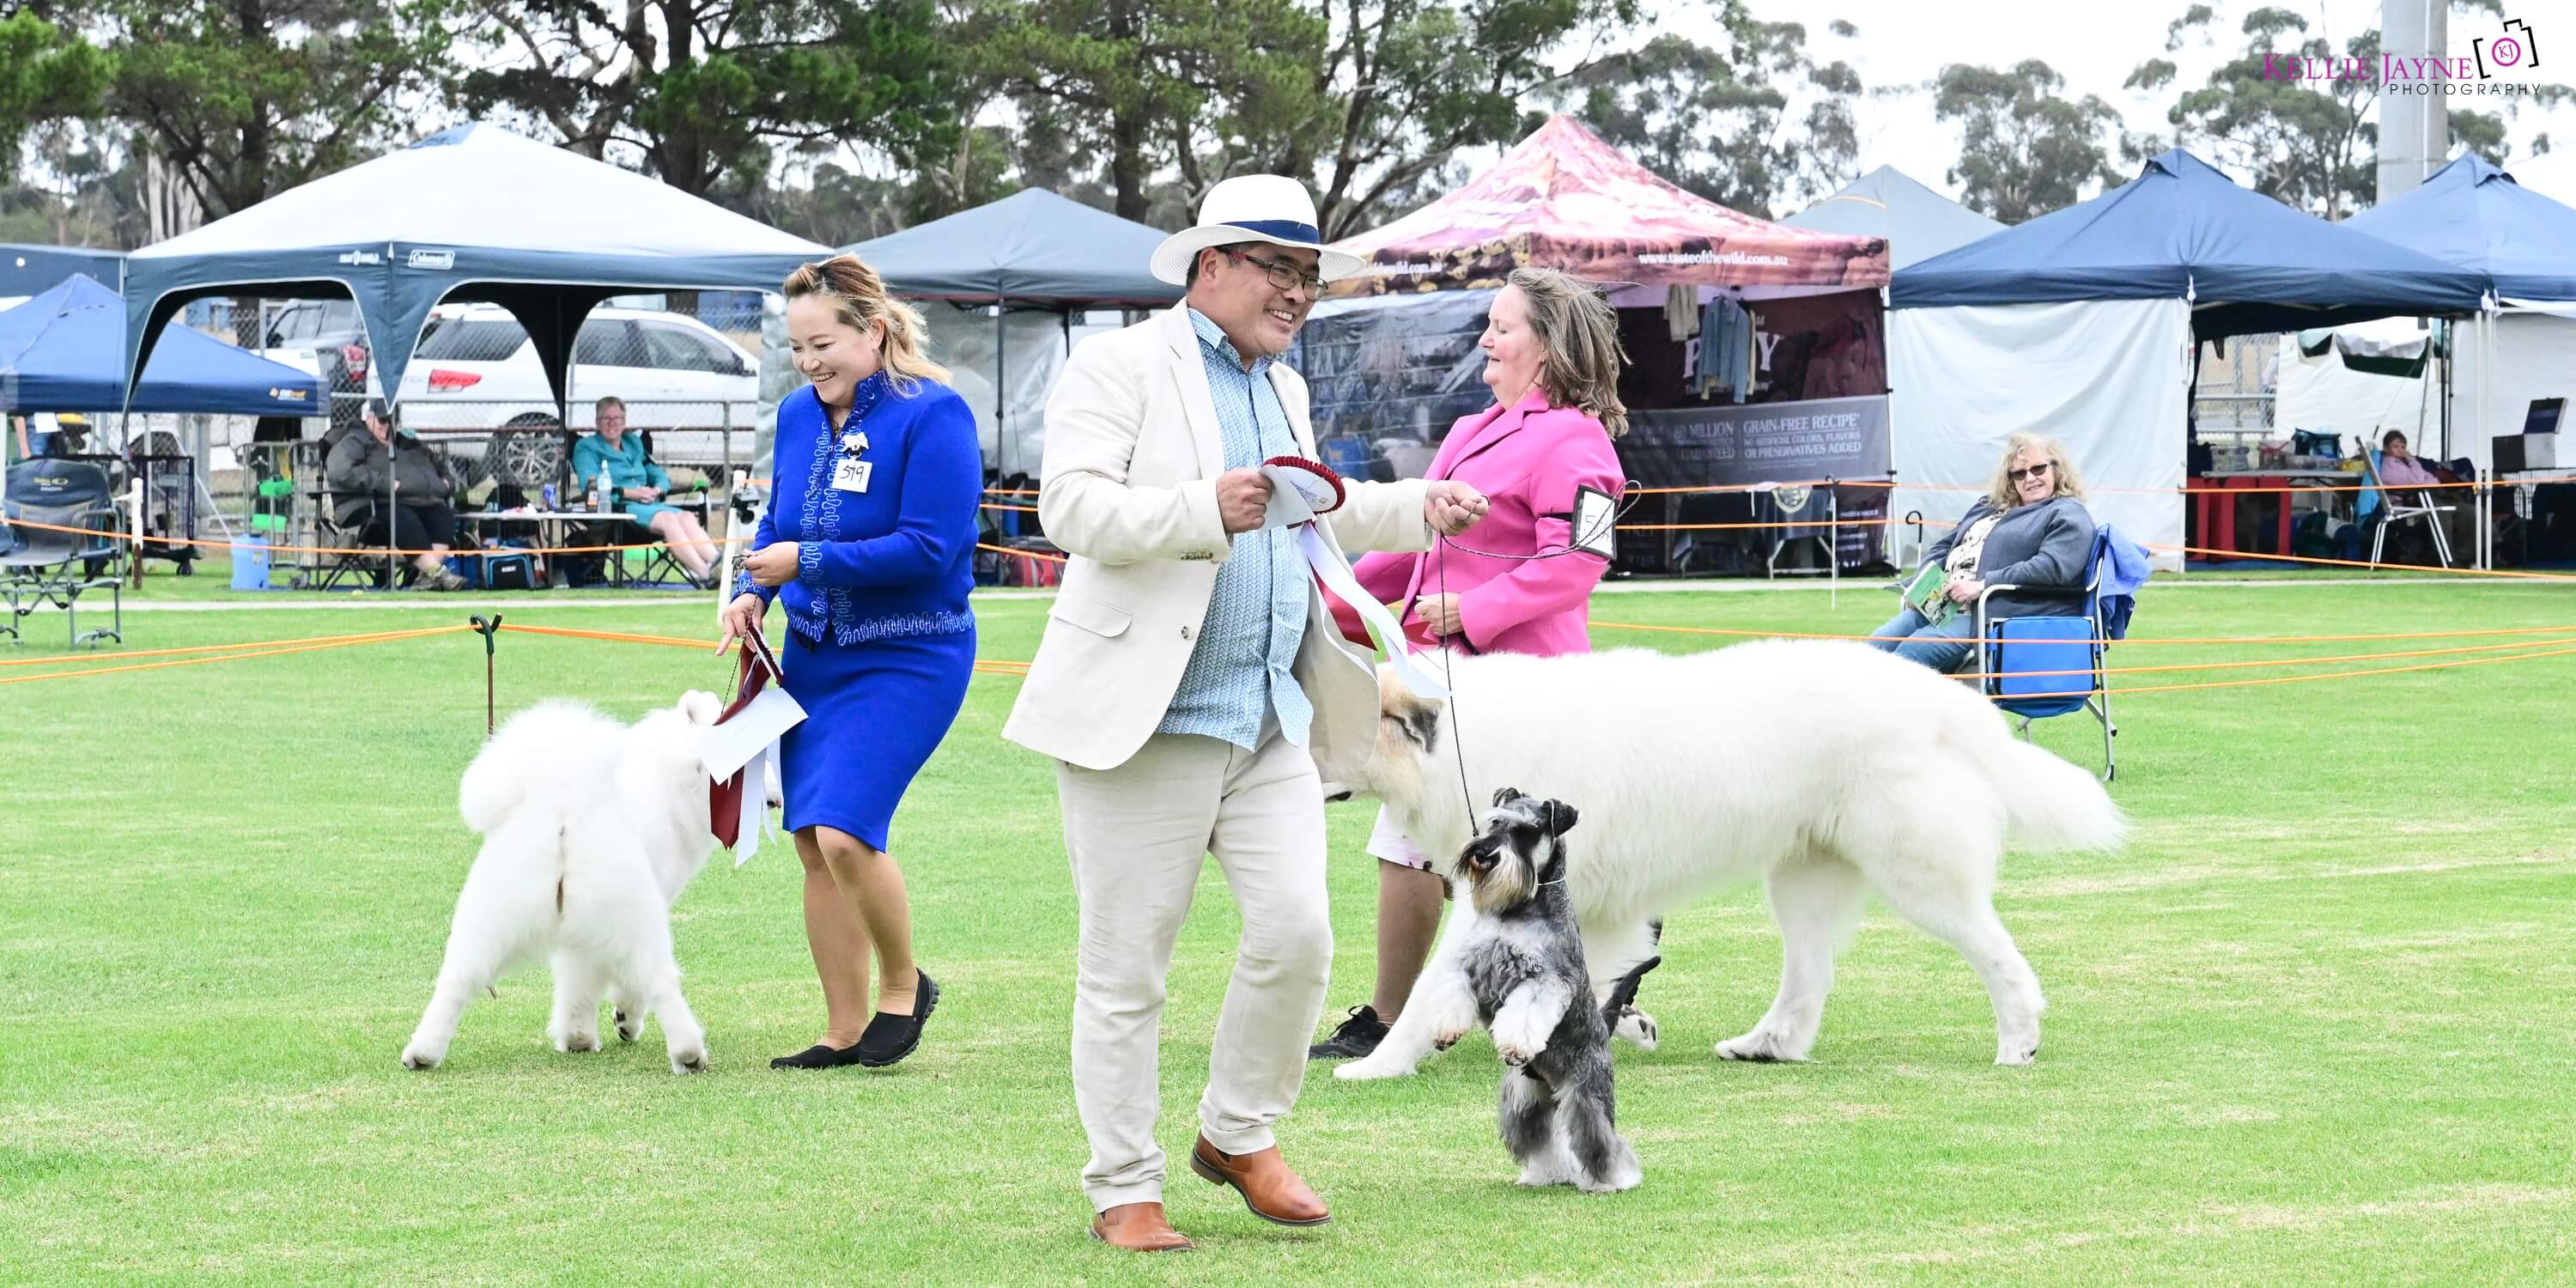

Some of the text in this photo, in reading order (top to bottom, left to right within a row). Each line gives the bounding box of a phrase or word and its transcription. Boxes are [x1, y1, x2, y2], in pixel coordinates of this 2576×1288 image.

[1638, 250, 1789, 265] www.tasteofthewild.com.au
[1743, 416, 1809, 434] GRAIN-FREE
[1744, 441, 1862, 459] OR PRESERVATIVES ADDED
